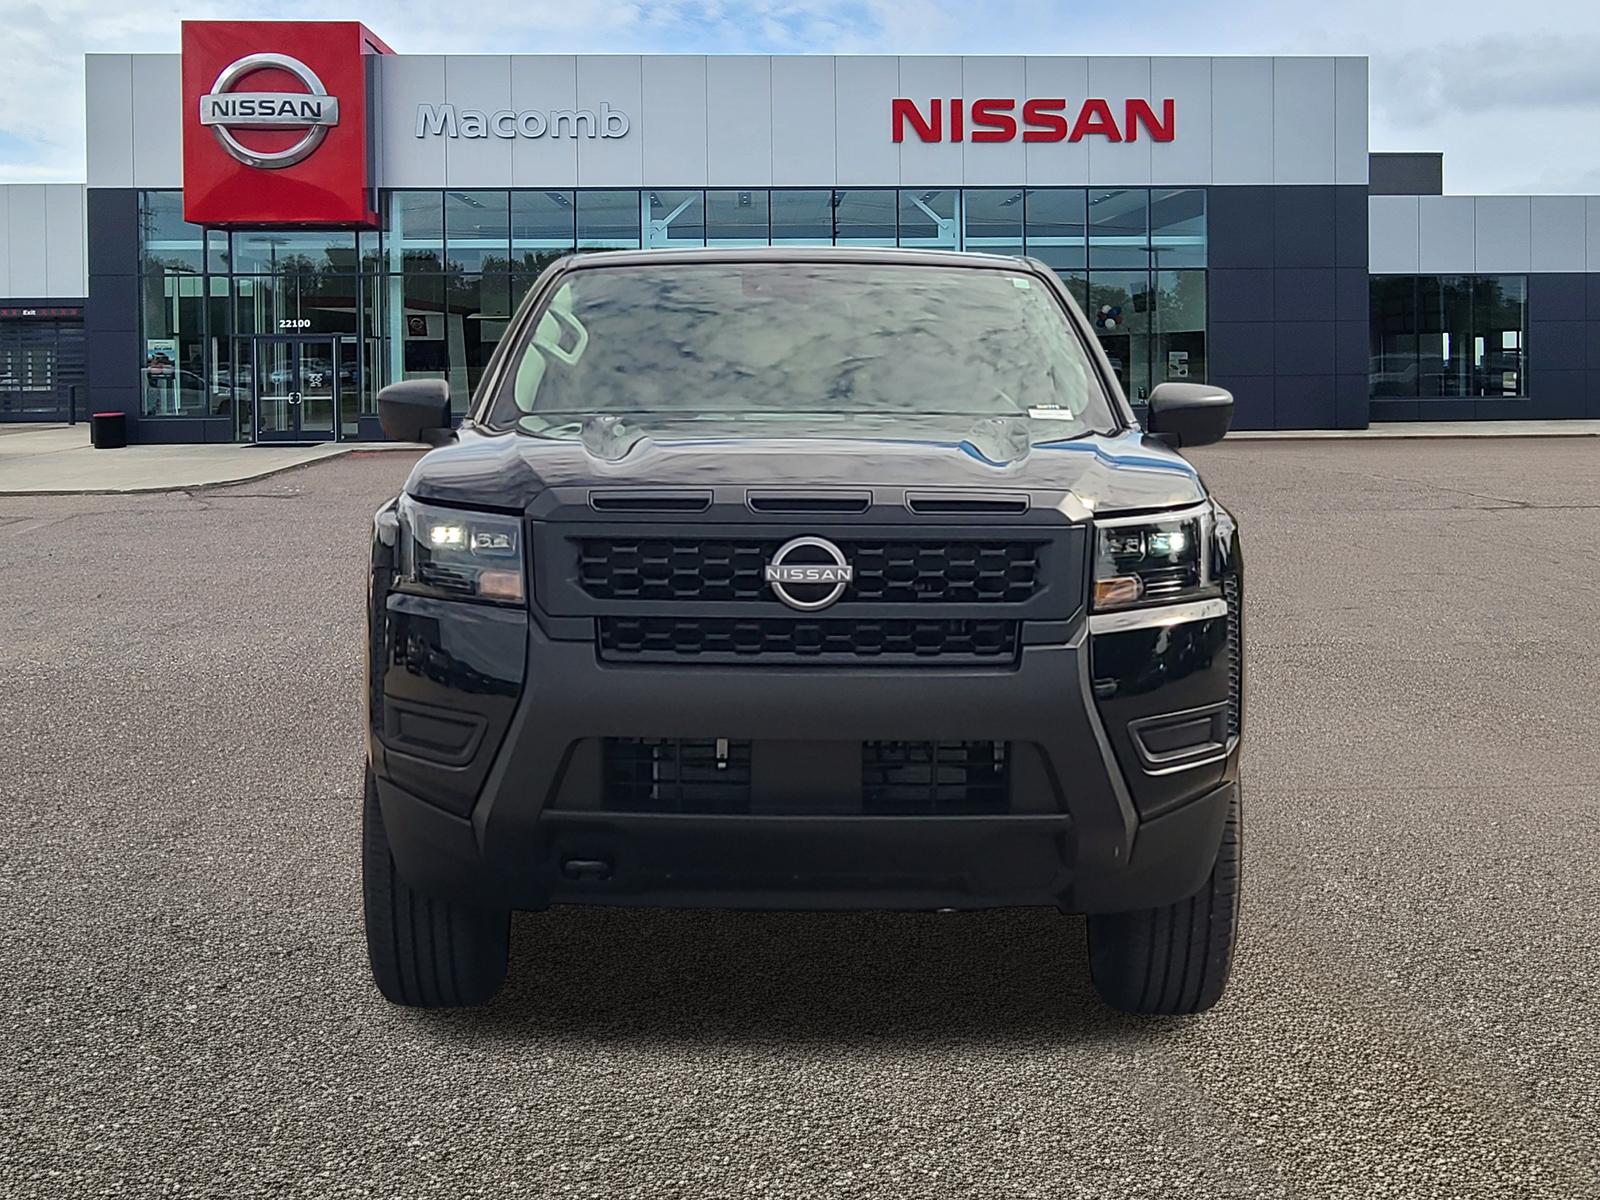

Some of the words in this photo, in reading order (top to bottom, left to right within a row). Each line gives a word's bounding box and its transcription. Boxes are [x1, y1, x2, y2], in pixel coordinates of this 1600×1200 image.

[212, 100, 322, 118] NISSAN
[415, 101, 630, 139] Macomb
[892, 98, 1175, 143] NISSAN
[279, 319, 311, 328] 22100
[767, 568, 851, 580] NISSAN
